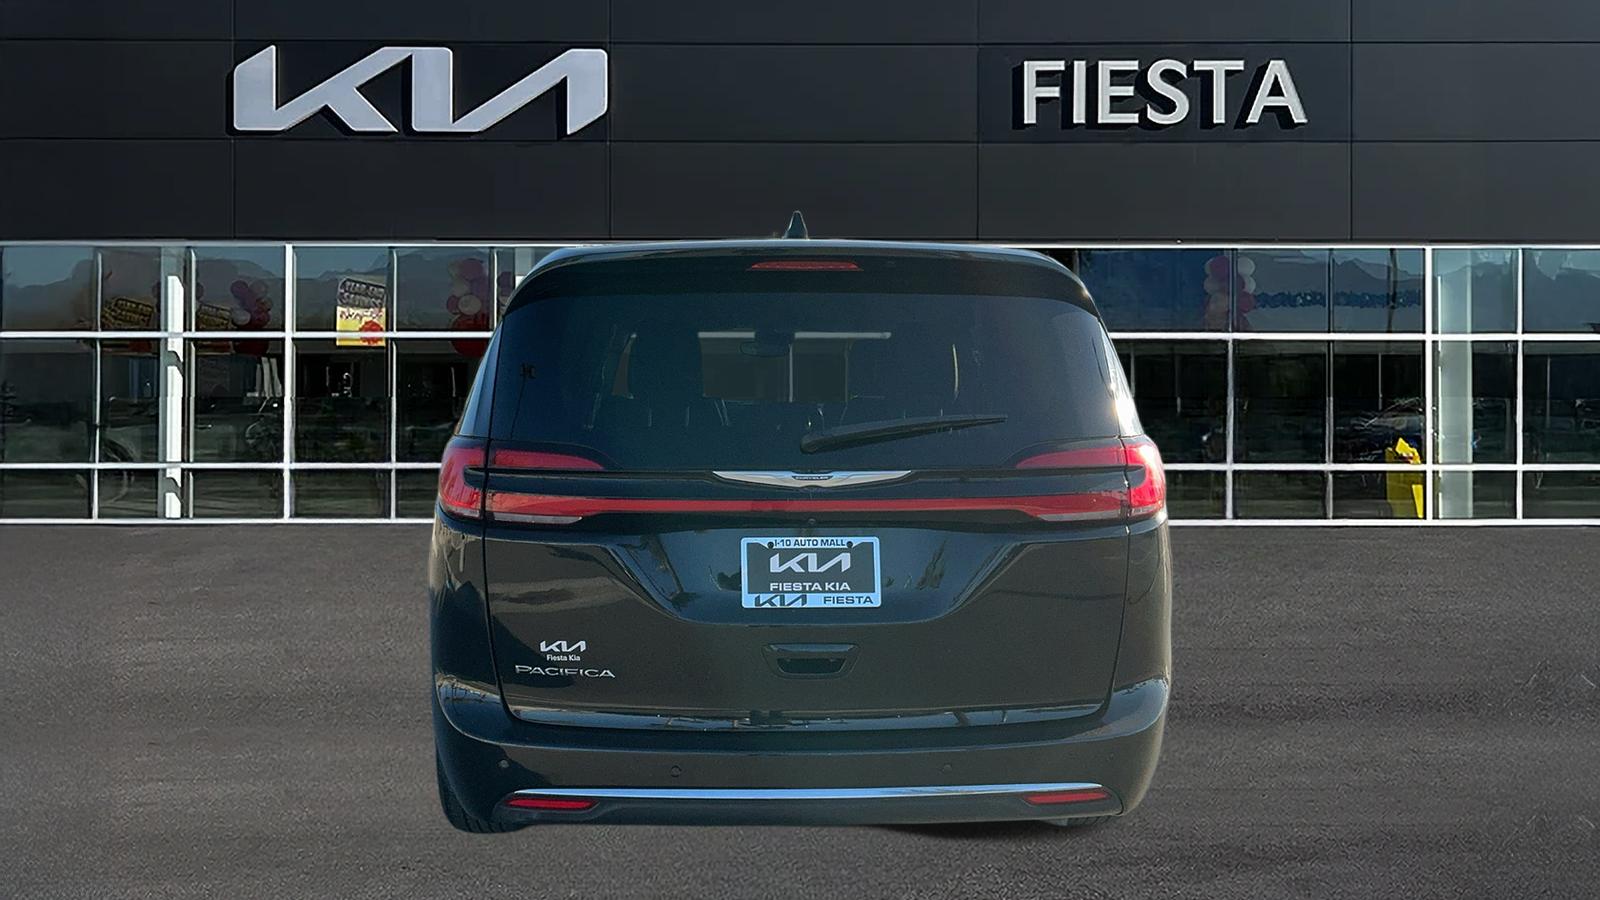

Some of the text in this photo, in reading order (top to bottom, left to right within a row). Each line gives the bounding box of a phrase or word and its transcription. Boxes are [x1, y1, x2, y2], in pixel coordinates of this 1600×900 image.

[233, 45, 608, 135] KIA
[1023, 59, 1308, 125] FIESTA
[774, 539, 845, 547] I-10 AUTO MALL
[770, 552, 851, 573] KIA
[770, 582, 851, 591] FIESTA KIA
[823, 596, 873, 604] FIESTA
[515, 664, 616, 678] PACIFICA
